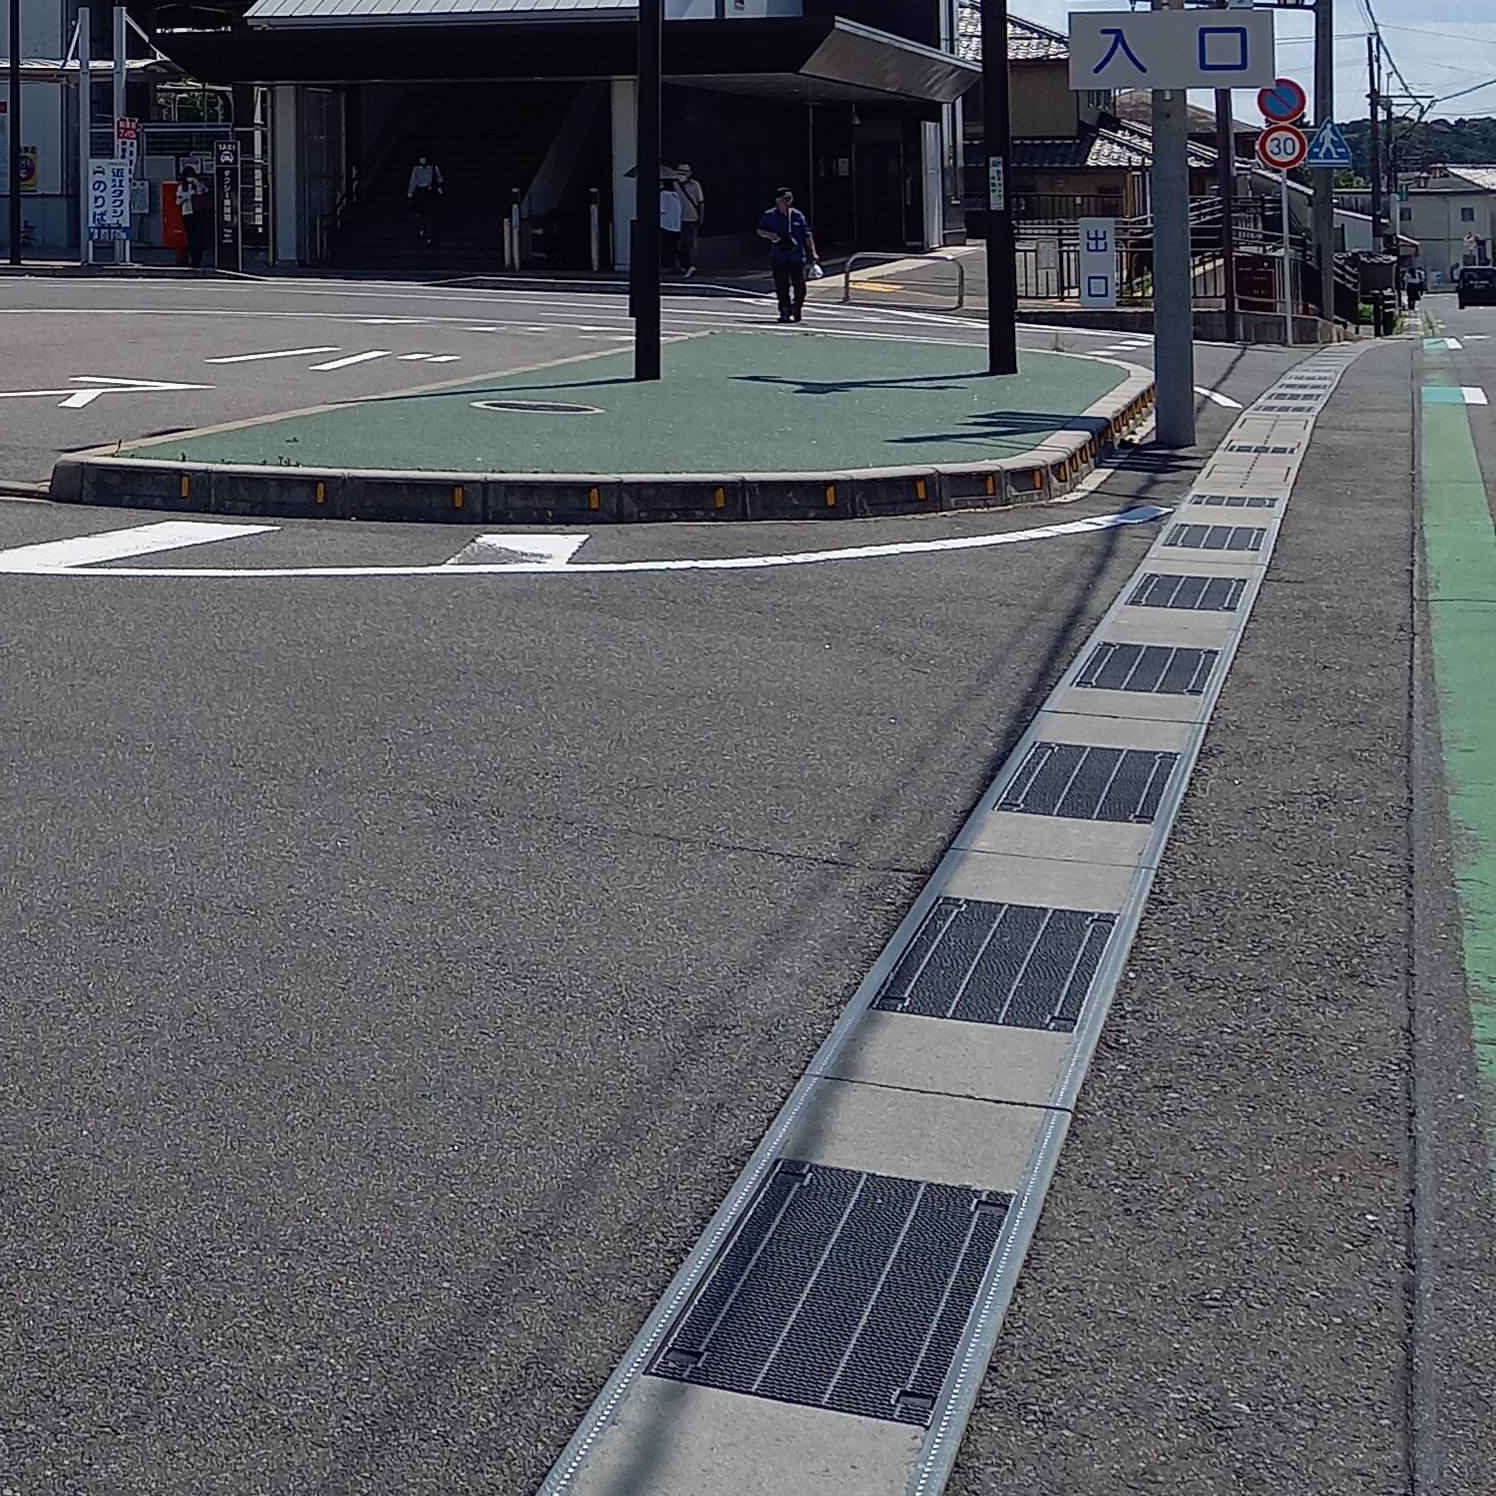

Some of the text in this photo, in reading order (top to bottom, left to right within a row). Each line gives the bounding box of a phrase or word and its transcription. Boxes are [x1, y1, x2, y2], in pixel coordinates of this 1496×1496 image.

[1092, 26, 1248, 74] 入口
[1270, 137, 1296, 156] 30
[92, 180, 108, 225] のりば
[1086, 229, 1109, 298] 出口
